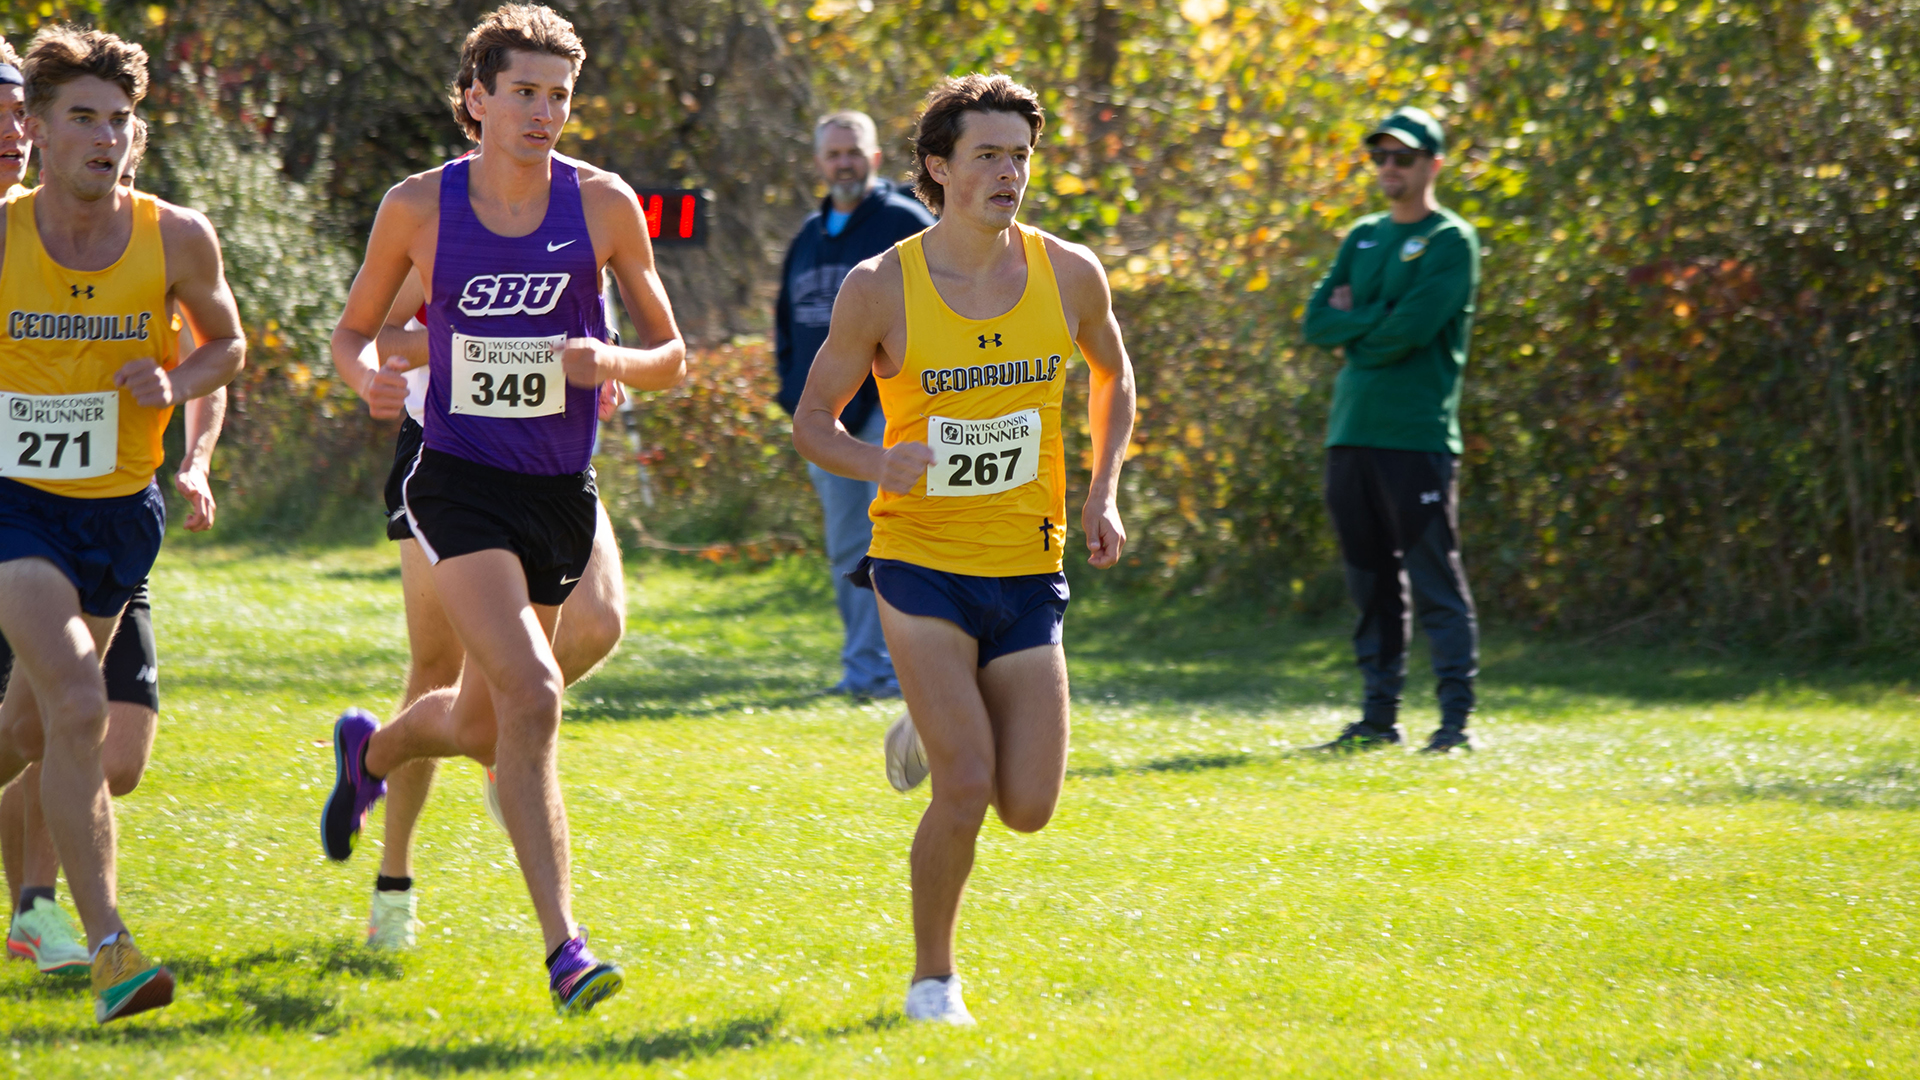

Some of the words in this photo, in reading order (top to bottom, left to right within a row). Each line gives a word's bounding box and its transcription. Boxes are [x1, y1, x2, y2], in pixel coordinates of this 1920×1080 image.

[457, 272, 571, 317] SBU
[7, 309, 152, 342] CEDARVILLE
[488, 350, 554, 365] RUNNER
[493, 340, 555, 351] WISCONSIN
[920, 354, 1062, 397] CEDARVILLE
[39, 396, 104, 409] WISCONSIN
[471, 371, 546, 408] 349
[34, 407, 104, 424] RUNNER
[970, 414, 1028, 432] WISCONSIN
[965, 424, 1030, 446] RUNNER
[18, 430, 91, 468] 271
[948, 446, 1022, 487] 267
